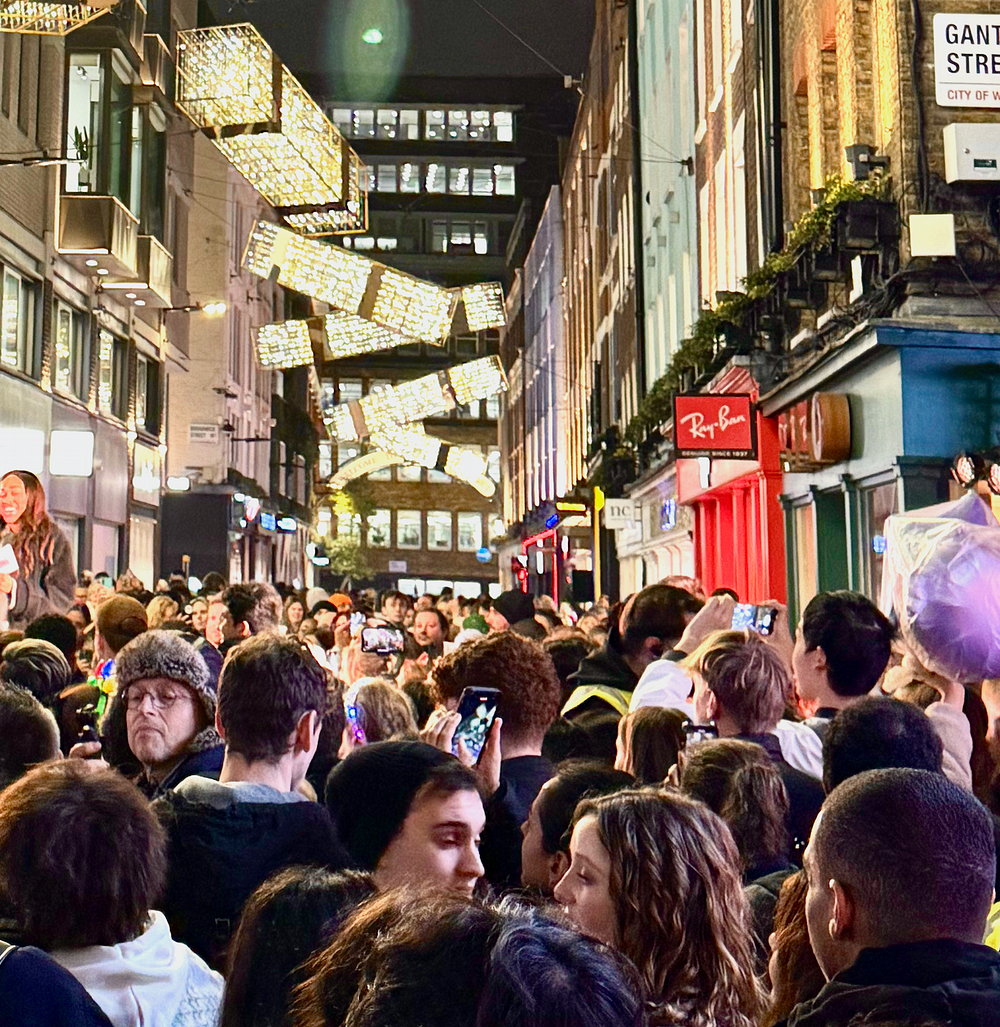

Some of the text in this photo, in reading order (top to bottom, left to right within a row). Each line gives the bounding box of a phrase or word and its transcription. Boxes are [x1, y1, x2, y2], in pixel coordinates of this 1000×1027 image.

[947, 89, 971, 101] CITY
[975, 90, 989, 101] OF
[610, 505, 631, 517] nc
